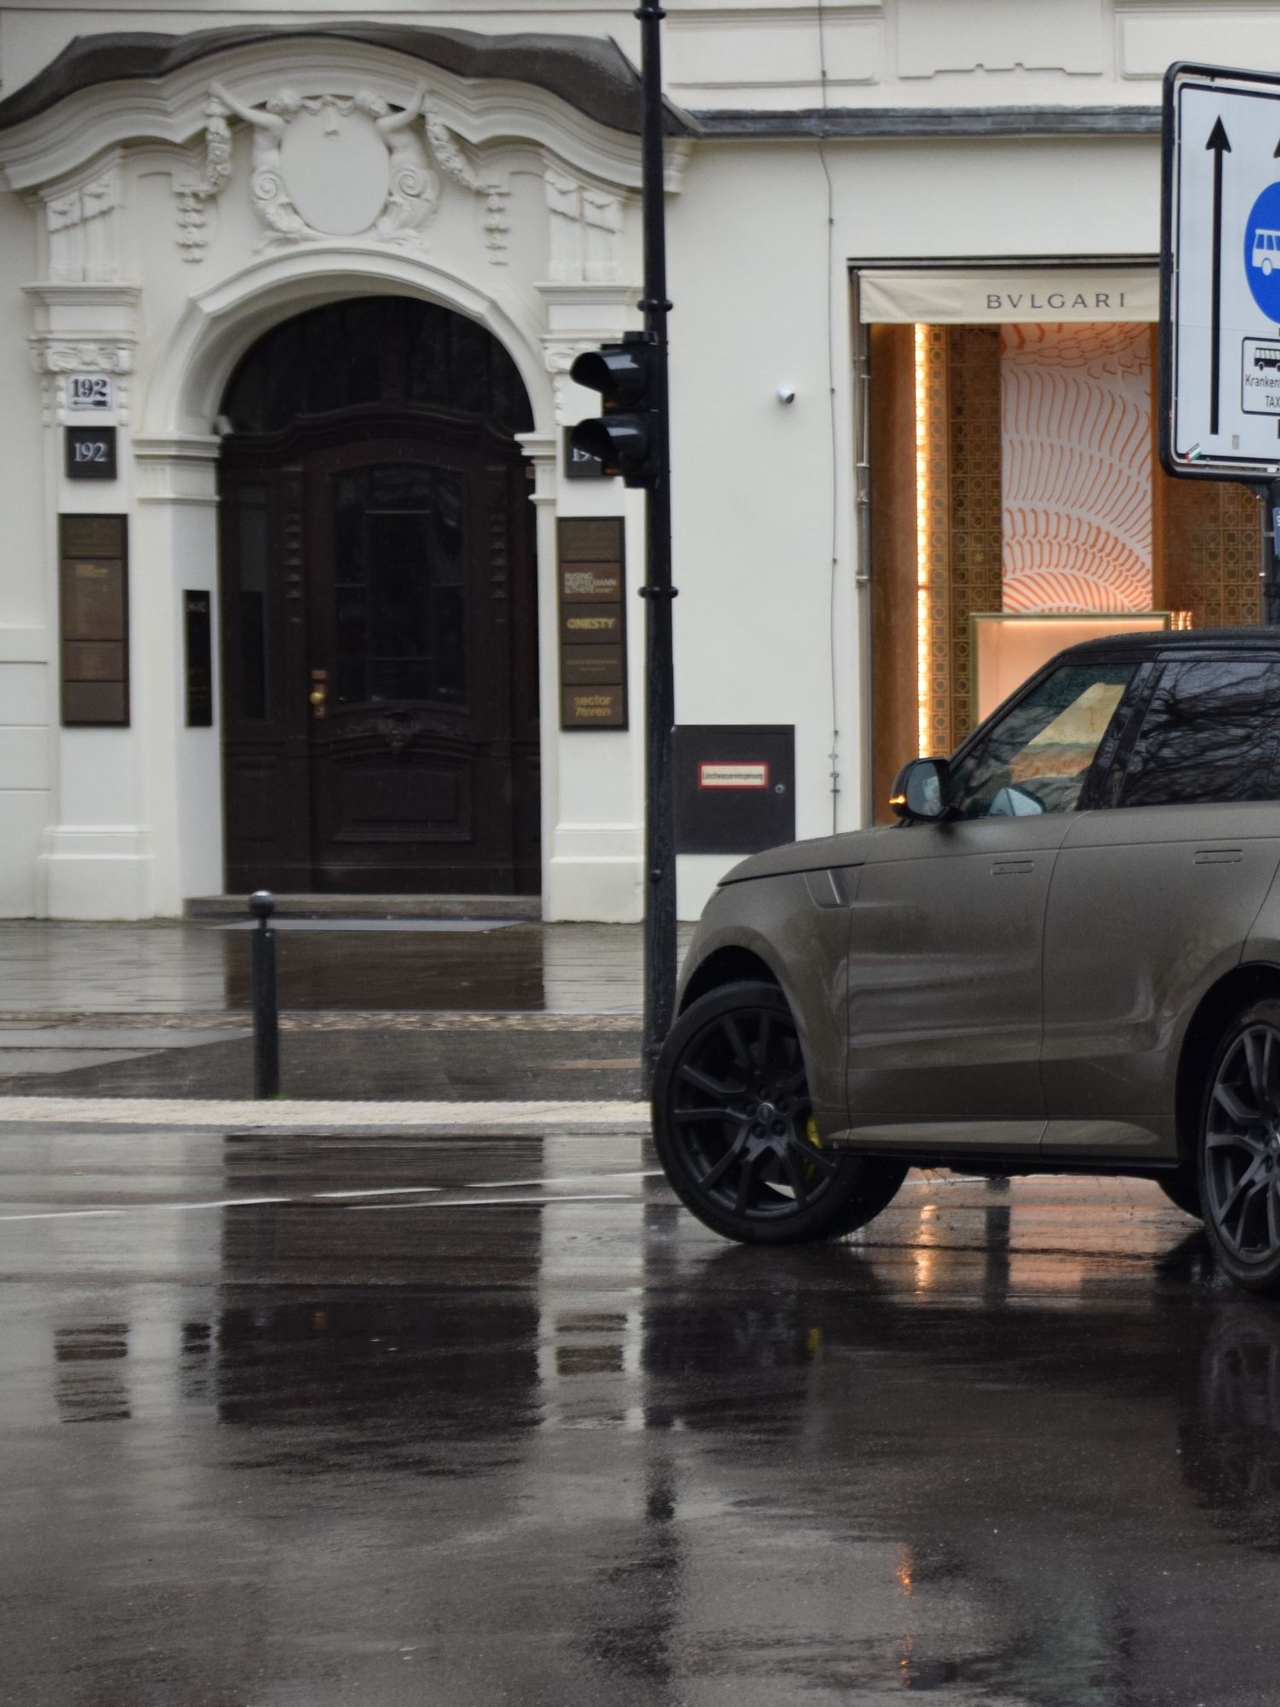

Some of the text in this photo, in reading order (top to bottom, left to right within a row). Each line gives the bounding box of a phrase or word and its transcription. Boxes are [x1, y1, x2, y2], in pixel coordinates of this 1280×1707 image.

[986, 292, 1125, 309] BVLGARI
[71, 379, 107, 397] 192
[74, 442, 106, 462] 192
[574, 695, 612, 705] sector
